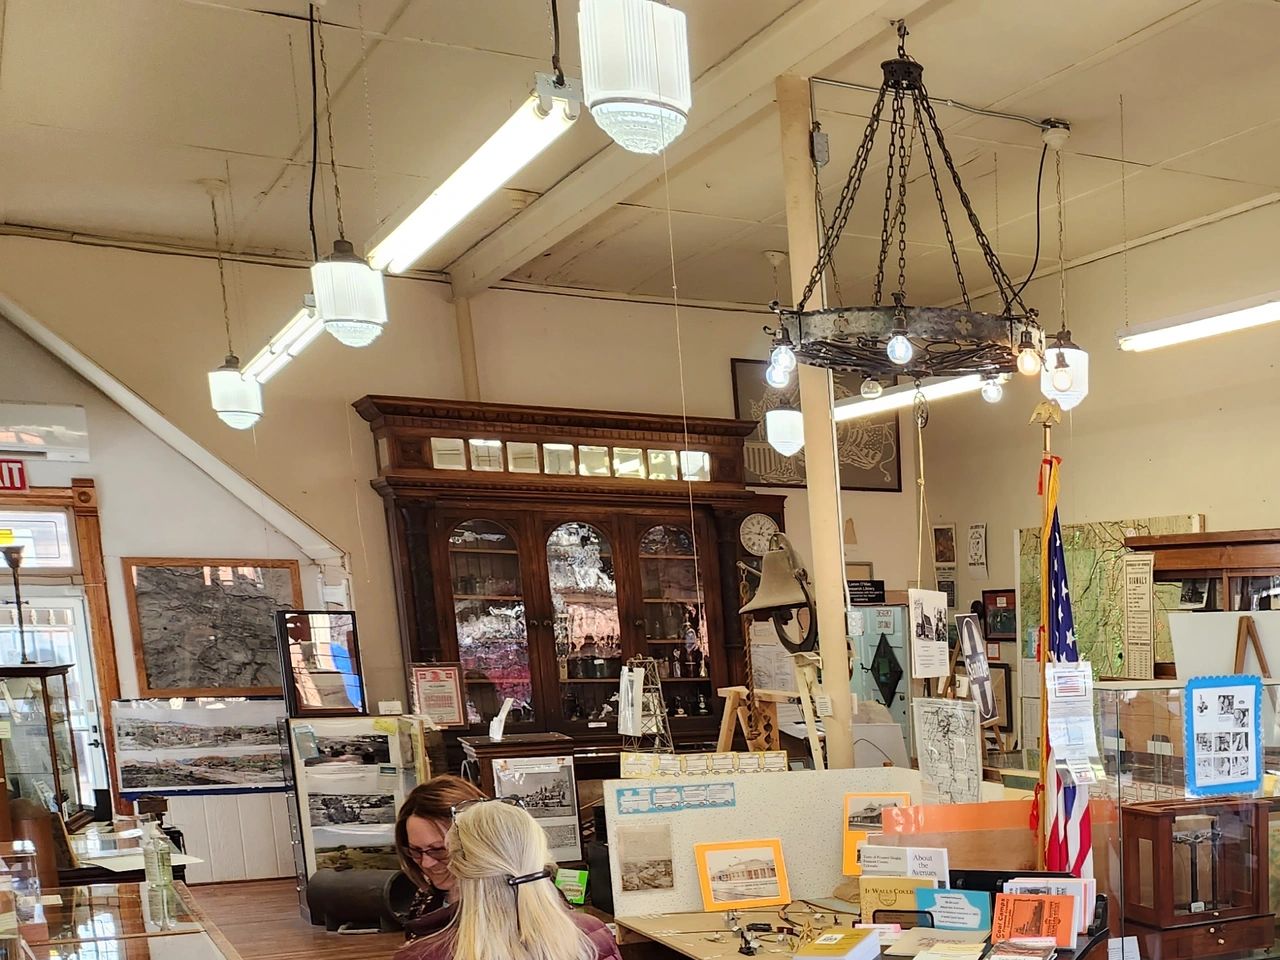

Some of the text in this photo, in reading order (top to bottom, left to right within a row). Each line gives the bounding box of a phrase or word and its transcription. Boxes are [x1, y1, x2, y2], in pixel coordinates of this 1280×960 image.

[913, 854, 932, 862] About
[912, 869, 937, 877] Avenues
[998, 898, 1006, 922] Camps
